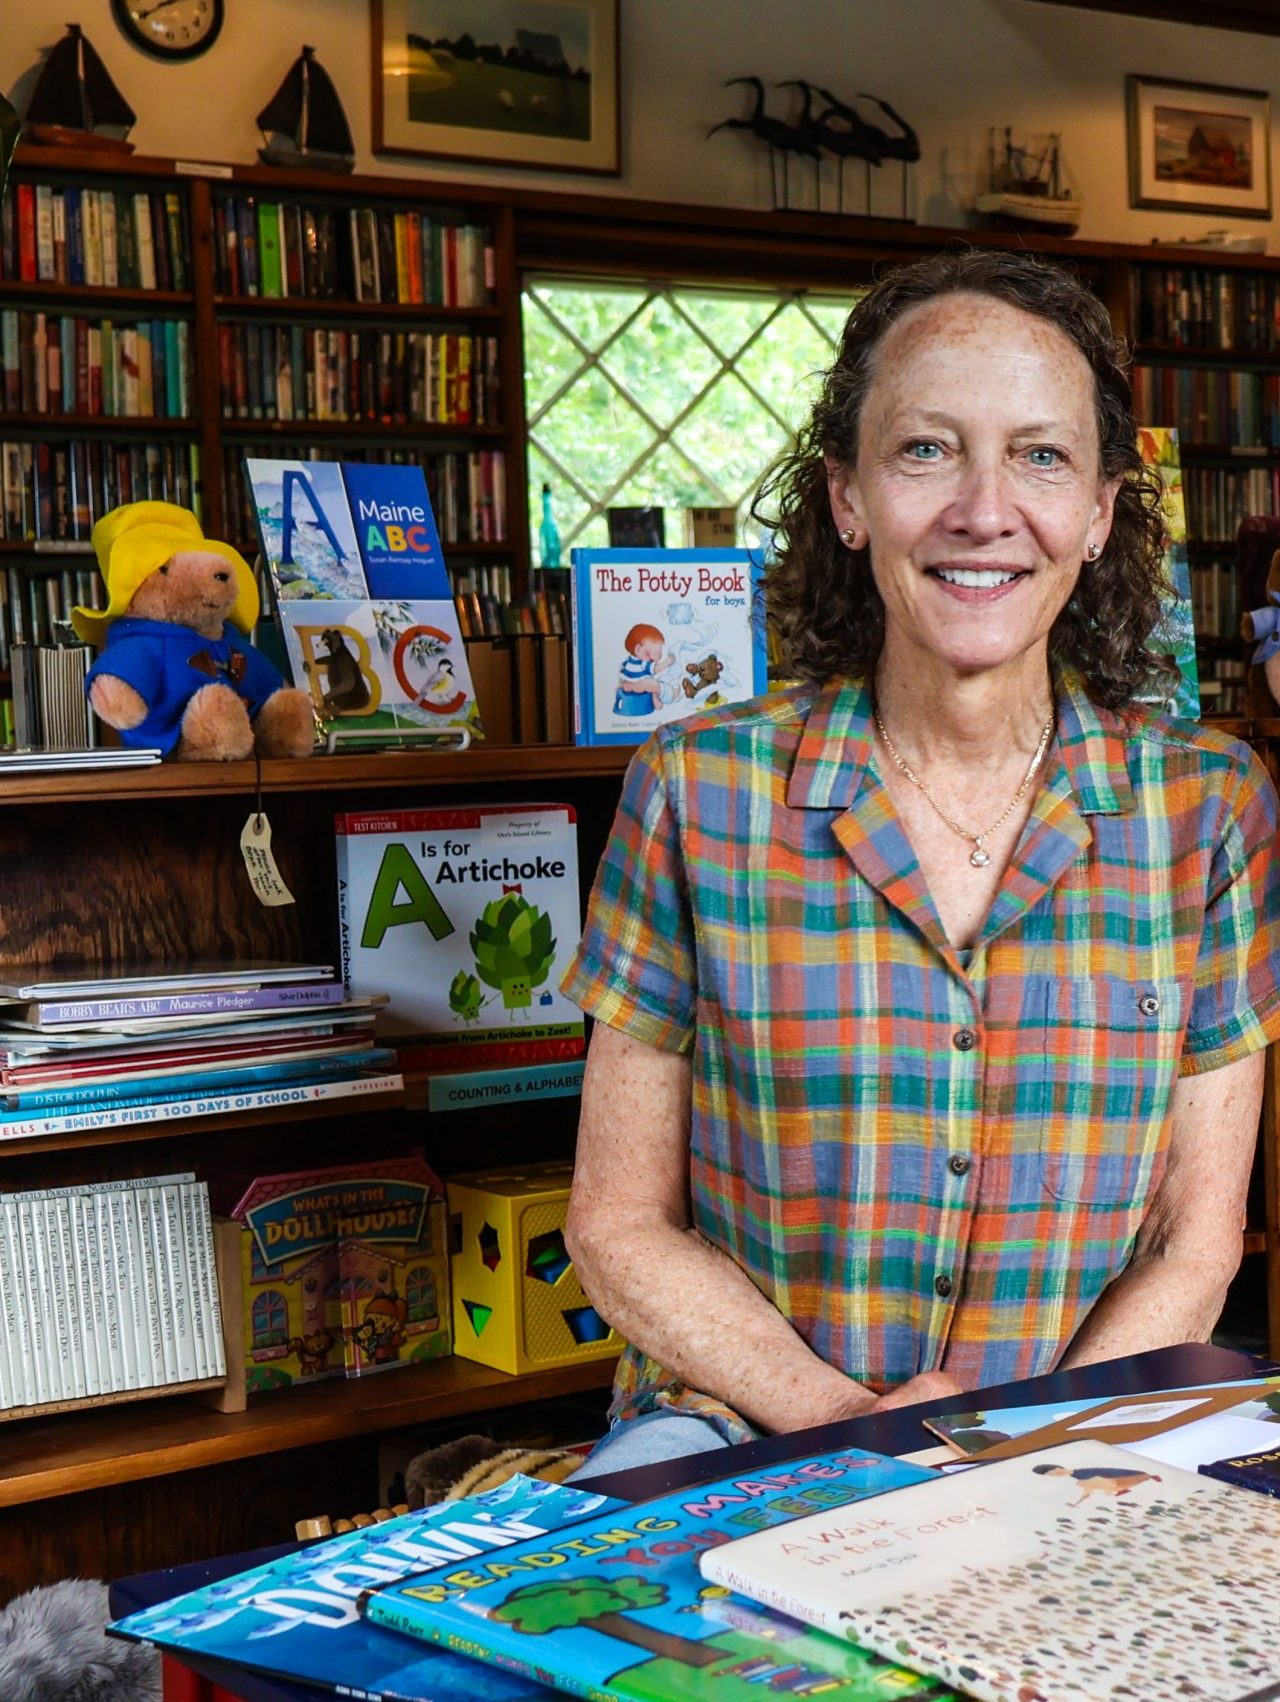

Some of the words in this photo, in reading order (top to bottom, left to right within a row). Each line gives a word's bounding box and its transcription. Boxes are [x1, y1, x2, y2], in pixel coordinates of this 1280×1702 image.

[281, 470, 348, 566] A
[359, 499, 425, 522] Maine
[367, 525, 432, 553] ABC
[597, 569, 632, 592] The
[638, 568, 693, 598] Potty
[698, 568, 745, 592] Book
[705, 596, 721, 606] for
[724, 595, 746, 607] boys
[293, 624, 382, 717] B
[393, 624, 467, 715] C
[353, 823, 369, 832] TEST
[370, 821, 398, 831] KITCHEN
[421, 842, 437, 858] Is
[443, 840, 471, 856] for
[435, 856, 566, 885] Artichoke
[360, 843, 455, 949] A
[59, 1004, 95, 1018] BOBBY
[99, 1002, 136, 1016] BEAR'S
[139, 1001, 161, 1013] ABC
[169, 995, 214, 1011] Maurice
[217, 996, 255, 1009] Pledger
[64, 1113, 117, 1130] EMILY'S
[121, 1108, 157, 1122] FIRST
[163, 1104, 193, 1117] 100
[197, 1099, 230, 1113] DAYS
[235, 1096, 253, 1108] OF
[256, 1089, 308, 1105] SCHOOL
[352, 1080, 396, 1091] HYPERION
[448, 1083, 512, 1101] COUNTING
[514, 1082, 523, 1093] &
[13, 1191, 43, 1201] CECILY
[45, 1187, 86, 1198] PARSLEY'S
[88, 1182, 124, 1193] NURSERY
[125, 1177, 159, 1190] RHYMES
[293, 1195, 340, 1212] WHAT'S
[342, 1191, 358, 1204] IN
[360, 1187, 385, 1201] THE
[166, 1194, 175, 1214] THE
[168, 1215, 177, 1239] TALE
[172, 1250, 180, 1281] LITTLE
[174, 1282, 183, 1297] PIG
[176, 1300, 186, 1338] ROBINSON
[399, 1517, 680, 1604] READING
[680, 1455, 883, 1519] MAKES
[597, 1529, 733, 1567] YOU
[725, 1481, 884, 1531] FEEL
[780, 1540, 808, 1555] A
[806, 1516, 896, 1545] Walk
[802, 1551, 841, 1566] in
[843, 1535, 894, 1555] the
[894, 1506, 999, 1541] Forest
